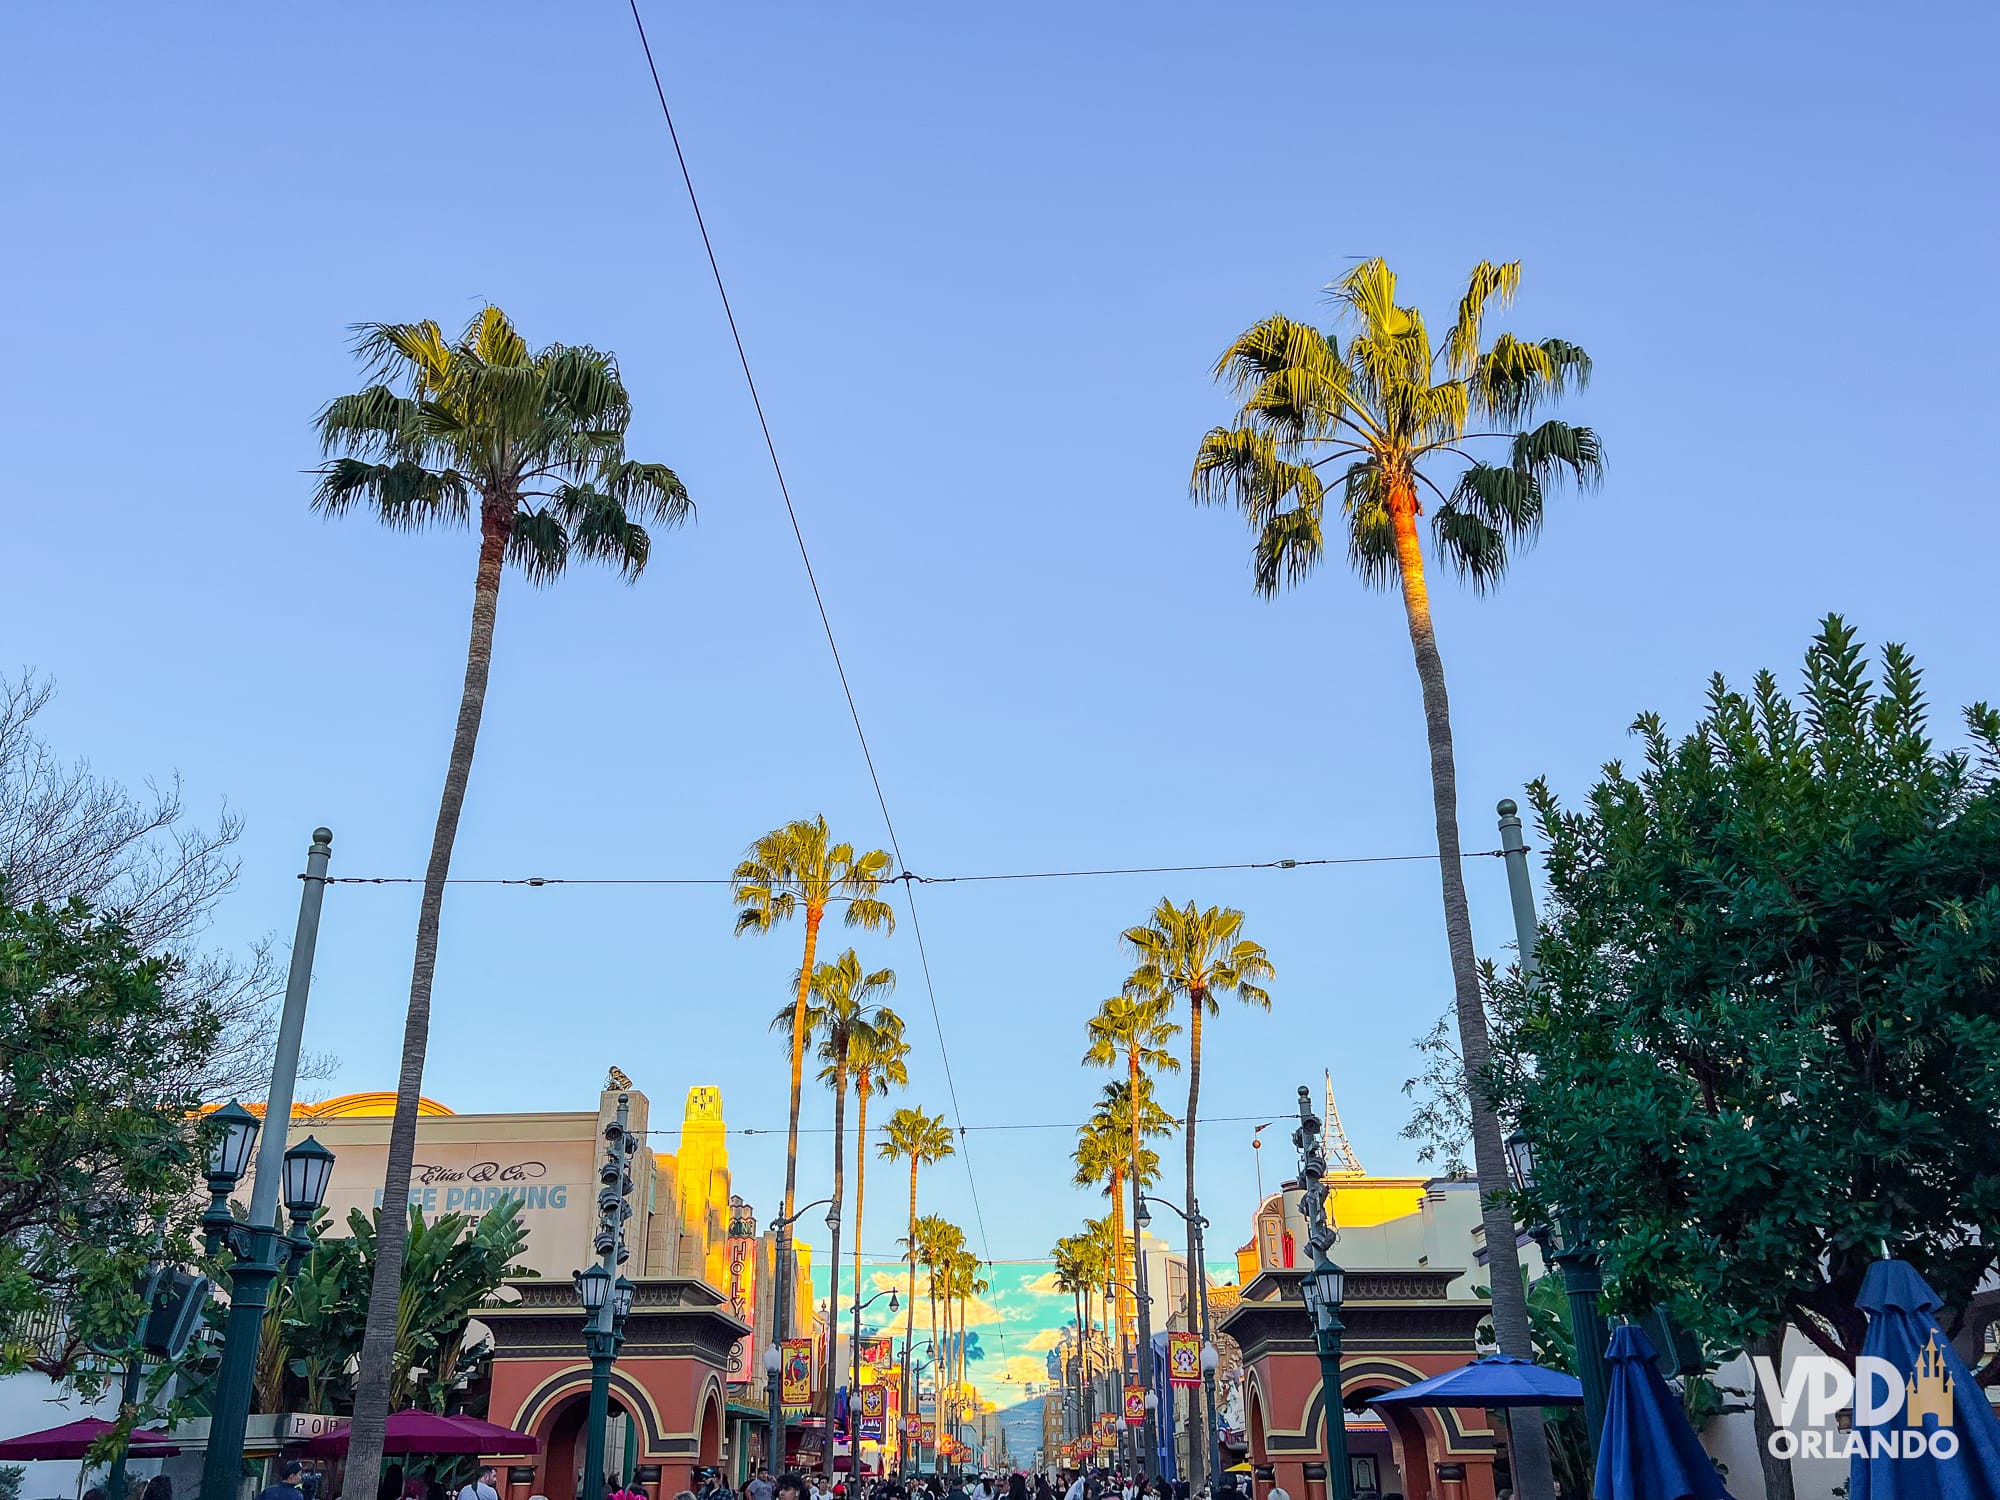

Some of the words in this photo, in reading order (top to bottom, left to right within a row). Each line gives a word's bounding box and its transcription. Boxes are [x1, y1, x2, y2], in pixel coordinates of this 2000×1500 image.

[411, 1164, 465, 1185] Elias
[467, 1161, 500, 1182] &
[500, 1161, 547, 1181] Co.
[374, 1188, 437, 1211] FEE
[728, 1241, 747, 1373] HOLLYOD
